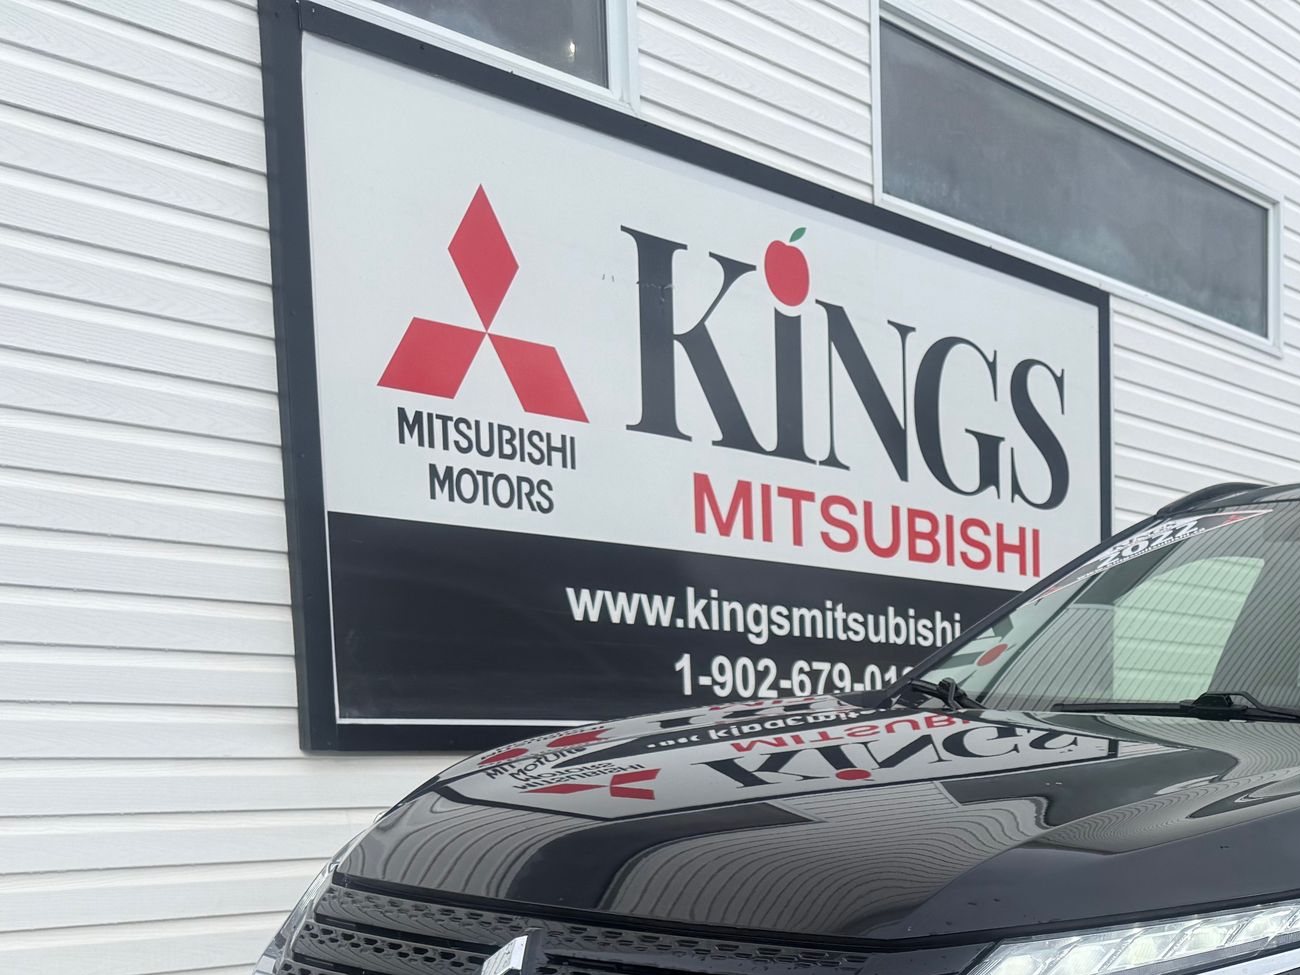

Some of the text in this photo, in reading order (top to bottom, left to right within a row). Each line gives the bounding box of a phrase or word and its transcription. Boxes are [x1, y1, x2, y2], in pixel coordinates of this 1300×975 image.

[397, 406, 577, 470] MITSUBISHI
[428, 463, 555, 514] MOTORS
[692, 471, 1041, 578] MITSUBISHI
[565, 586, 962, 648] www.kingsmitsubishi
[674, 653, 915, 700] 1-902-679-01
